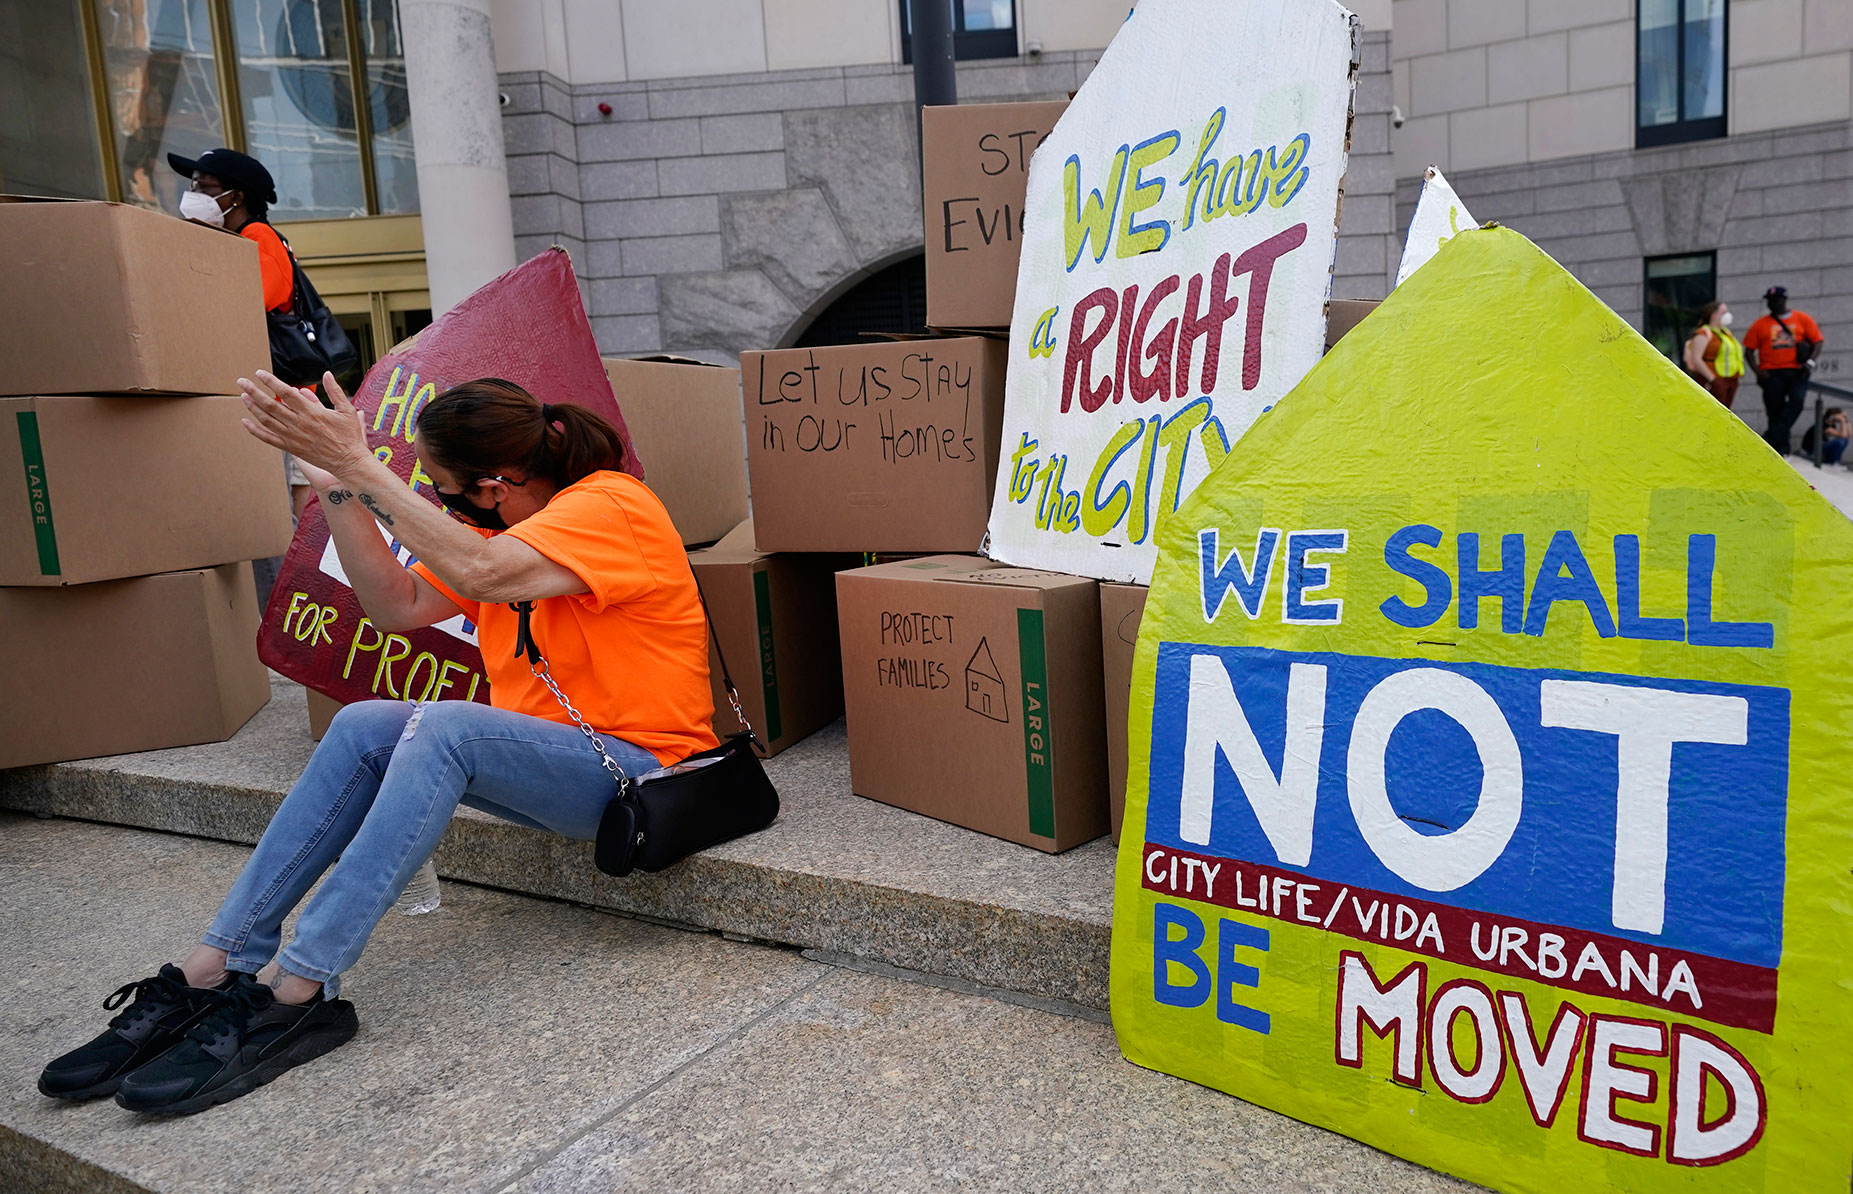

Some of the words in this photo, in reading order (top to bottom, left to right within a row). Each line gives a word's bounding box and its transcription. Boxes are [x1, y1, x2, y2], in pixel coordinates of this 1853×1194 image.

[978, 130, 1053, 176] ST
[1063, 130, 1182, 272] WE
[1179, 106, 1311, 231] have
[943, 197, 1026, 253] EVI
[1060, 222, 1308, 414] RIGHT
[759, 350, 820, 405] Let
[838, 365, 892, 407] us
[763, 414, 785, 452] in
[28, 464, 48, 525] LARGE
[1009, 432, 1040, 504] to
[1035, 453, 1081, 532] the
[282, 591, 339, 647] FOR
[1197, 526, 1349, 626] WE
[1379, 524, 1774, 649] SHALL
[342, 617, 491, 703] PROFI
[760, 624, 776, 688] LARGE
[881, 611, 954, 645] PROTECT
[877, 658, 950, 690] FAMILIES
[1026, 681, 1045, 767] LARGE
[1179, 654, 1749, 936] NOT
[1145, 850, 1221, 899] CITY
[1235, 870, 1445, 954] LIFE/VIDA
[1471, 921, 1704, 1010] URBANA
[1152, 902, 1272, 1036] BE
[1334, 949, 1768, 1167] MOVED
